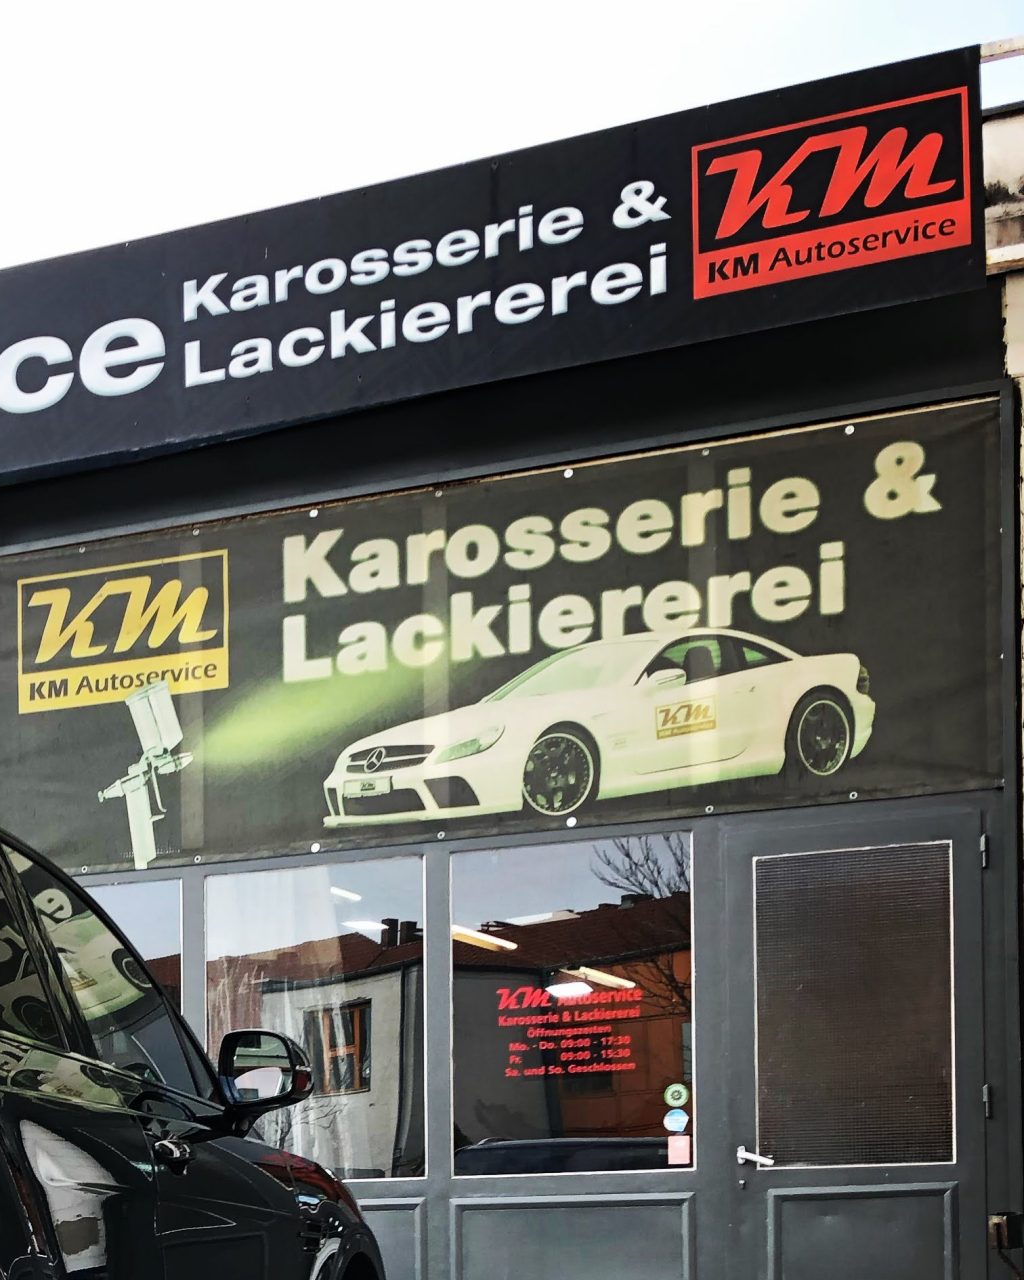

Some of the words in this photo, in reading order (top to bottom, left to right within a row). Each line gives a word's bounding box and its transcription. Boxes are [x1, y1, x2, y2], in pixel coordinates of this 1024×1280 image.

[182, 203, 585, 323] Karosserie
[612, 180, 672, 229] &
[707, 253, 760, 284] KM
[768, 217, 957, 272] Autoservice
[184, 242, 667, 388] Lackiererei
[283, 466, 821, 604] Karosserie
[864, 440, 943, 520] &
[282, 540, 845, 683] Lackiererei
[29, 678, 69, 701] KM
[75, 662, 218, 696] Autoservice
[498, 1012, 560, 1027] Karosserie
[561, 1010, 572, 1023] &
[574, 1004, 642, 1022] Lackiererei
[526, 1025, 613, 1039] Öffnungszeiten
[508, 1042, 530, 1052] Mo.
[538, 1040, 558, 1050] Do.
[560, 1038, 591, 1049] 09:00
[601, 1036, 632, 1046] 17:30
[509, 1054, 522, 1065] Fr.
[560, 1050, 591, 1061] 09:00
[601, 1048, 632, 1059] 15:30
[523, 1065, 546, 1076] und
[548, 1065, 566, 1075] So.
[568, 1062, 636, 1073] Geschlossen
